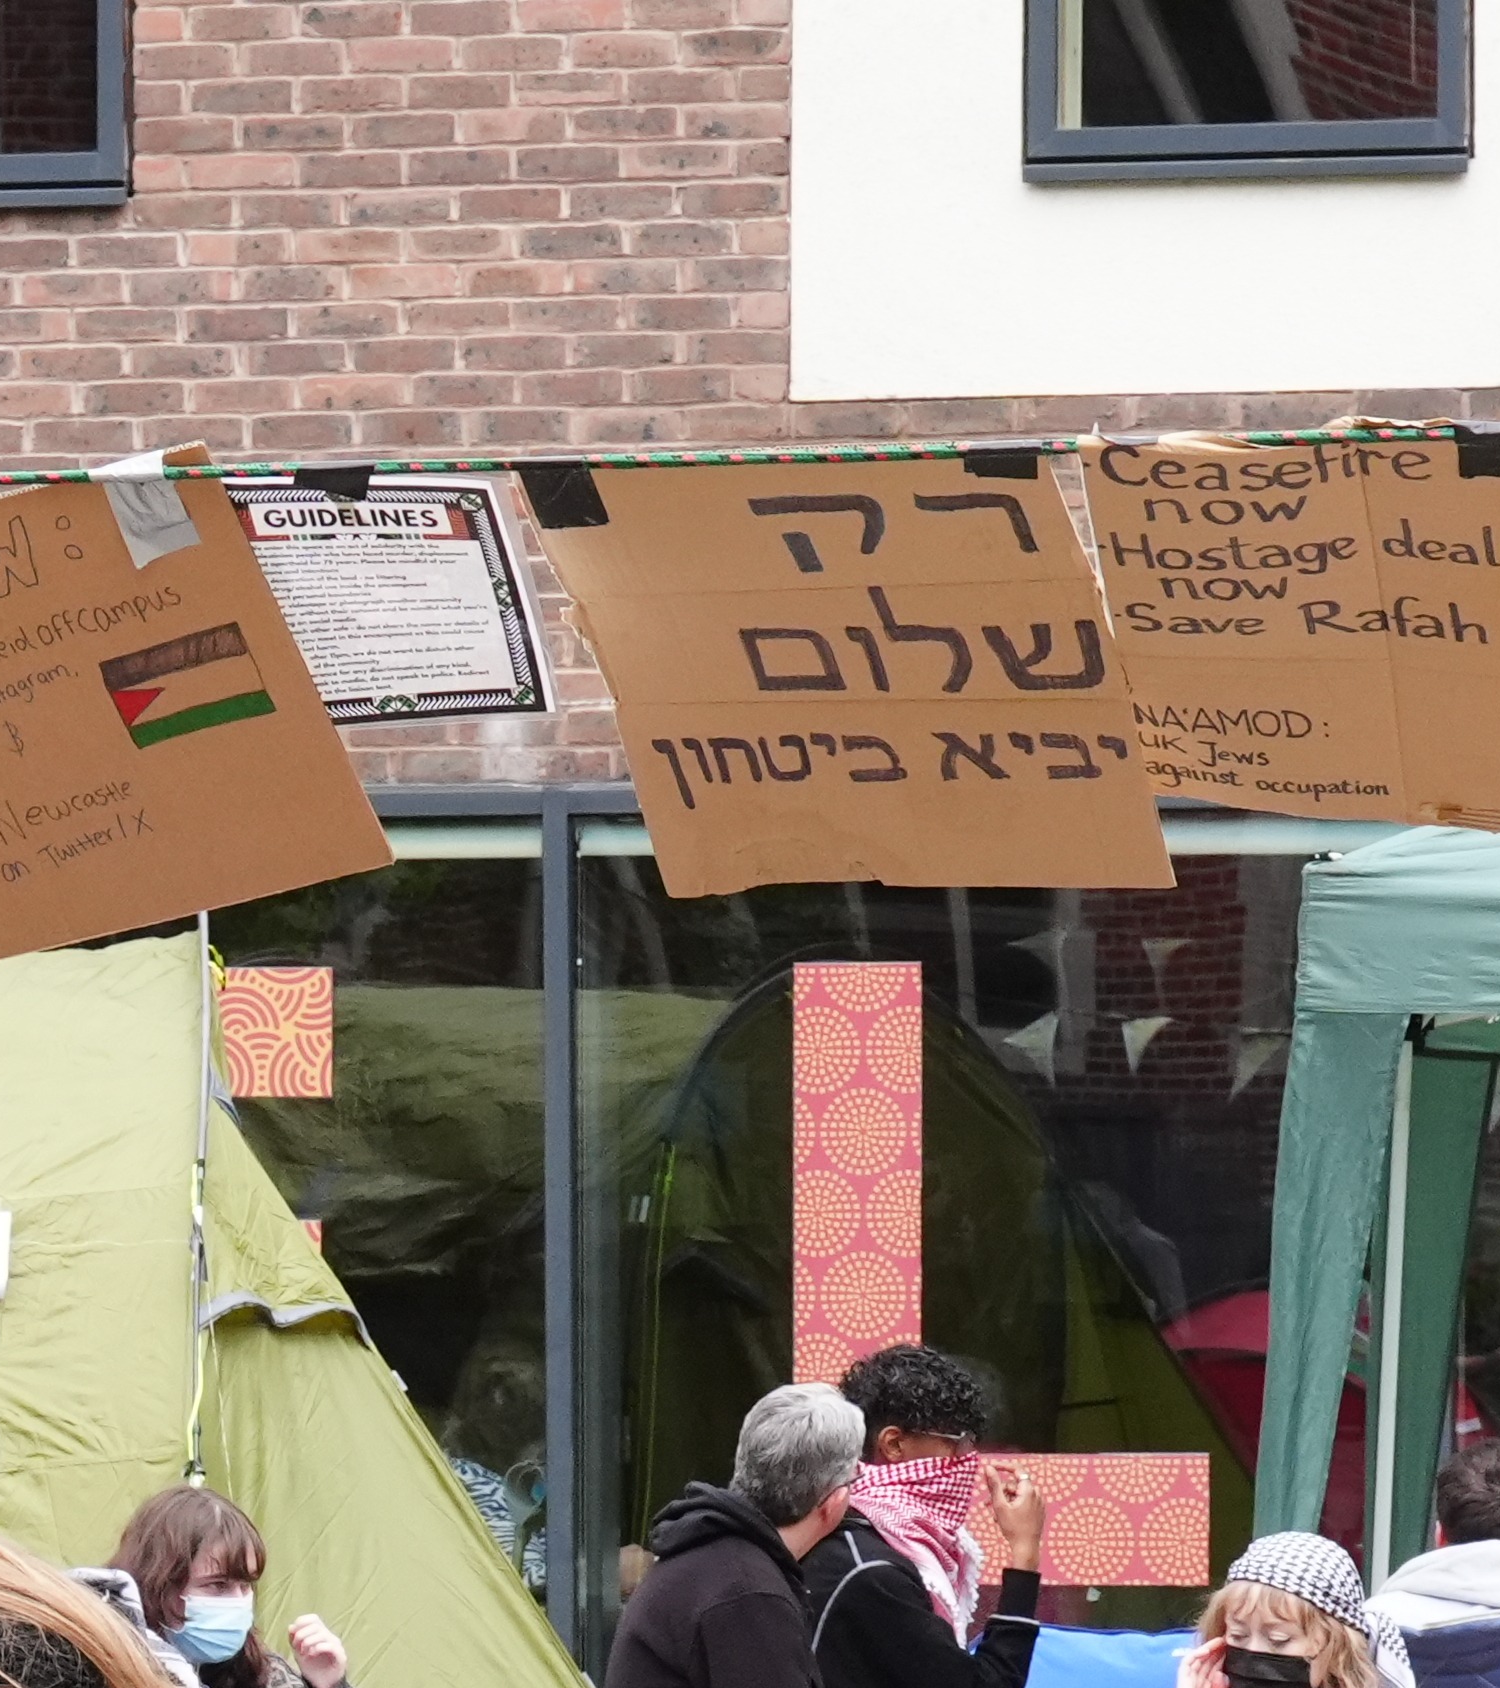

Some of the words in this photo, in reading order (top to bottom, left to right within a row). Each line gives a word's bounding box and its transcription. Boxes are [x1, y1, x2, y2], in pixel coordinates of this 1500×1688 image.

[264, 508, 438, 528] GUIDELINES
[747, 492, 1039, 572] רק
[1143, 496, 1308, 526] now
[1160, 576, 1289, 602] now
[739, 585, 1105, 692] שלום
[1297, 596, 1489, 645] Rafah
[652, 732, 908, 810] ביטחון
[932, 731, 1128, 782] יביא
[1198, 740, 1271, 768] Jews
[1146, 759, 1244, 788] against
[1255, 776, 1390, 802] occupation
[1, 860, 31, 883] on
